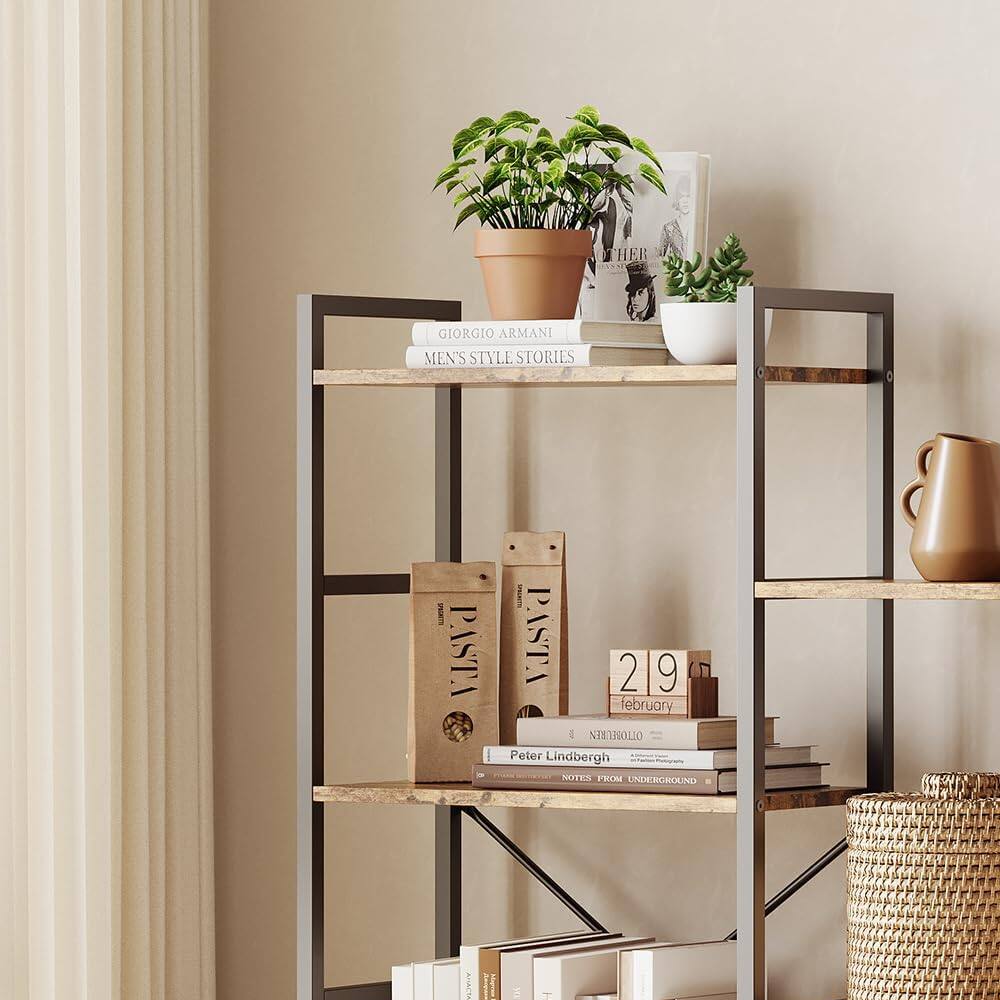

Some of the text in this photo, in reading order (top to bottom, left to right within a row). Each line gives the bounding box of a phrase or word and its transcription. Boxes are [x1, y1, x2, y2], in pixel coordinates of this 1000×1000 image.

[438, 326, 553, 340] GIORGIO ARMANI
[424, 348, 576, 366] MEN'S STYLE STORIES
[526, 589, 551, 684] PASTA
[450, 607, 478, 697] PASTA
[620, 695, 674, 716] february
[589, 729, 643, 741] OTTOBEUREN
[510, 749, 610, 766] Peter Lindbergh
[562, 773, 592, 782] NOTES
[597, 774, 623, 783] FROM
[628, 775, 697, 785] UNDERGROUND
